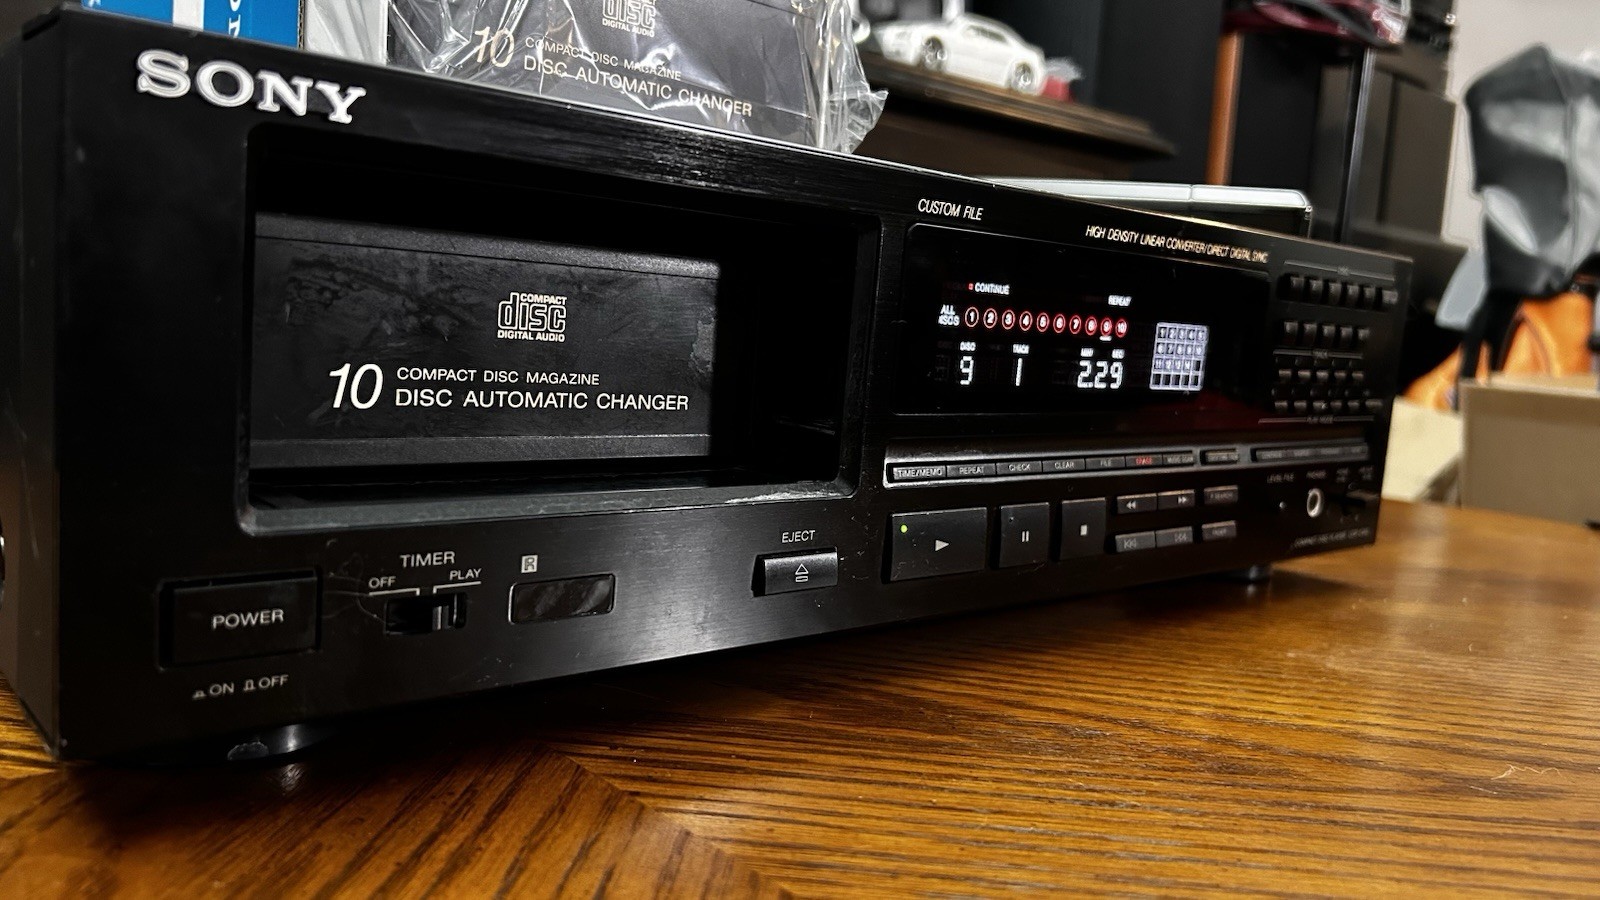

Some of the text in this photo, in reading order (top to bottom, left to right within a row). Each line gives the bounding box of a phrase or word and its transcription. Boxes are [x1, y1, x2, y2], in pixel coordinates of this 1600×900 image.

[602, 18, 655, 37] DIGITAL AUDIO
[474, 26, 515, 68] 10
[525, 37, 682, 82] COMPACT DISC MAGAZINE
[136, 49, 366, 124] SONY
[524, 55, 752, 117] DISC AUTOMATIC CHANGER
[917, 198, 984, 221] CUSTOM FILE
[1085, 225, 1106, 239] HIGH
[1107, 228, 1140, 243] DENSITY
[1140, 234, 1166, 248] LINEAR
[974, 282, 1010, 295] CONTINUE
[520, 293, 567, 306] COMPACT
[940, 304, 956, 315] ALL
[497, 329, 566, 342] DIGITAL AUDIO
[396, 367, 600, 386] COMPACT DISC MAGAZINE
[960, 355, 974, 385] 9
[328, 362, 384, 409] 10
[395, 388, 689, 411] DISC AUTOMATIC CHANGER
[898, 467, 942, 479] TIME/MEMO
[959, 466, 985, 475] REPEAT
[1008, 463, 1031, 472] CHECK
[1054, 461, 1075, 470] CLEAR
[781, 529, 816, 543] EJECT
[400, 551, 455, 568] TIMER
[368, 568, 482, 589] OFF PLAY
[212, 608, 285, 630] POWER
[209, 674, 289, 696] ON OFF
